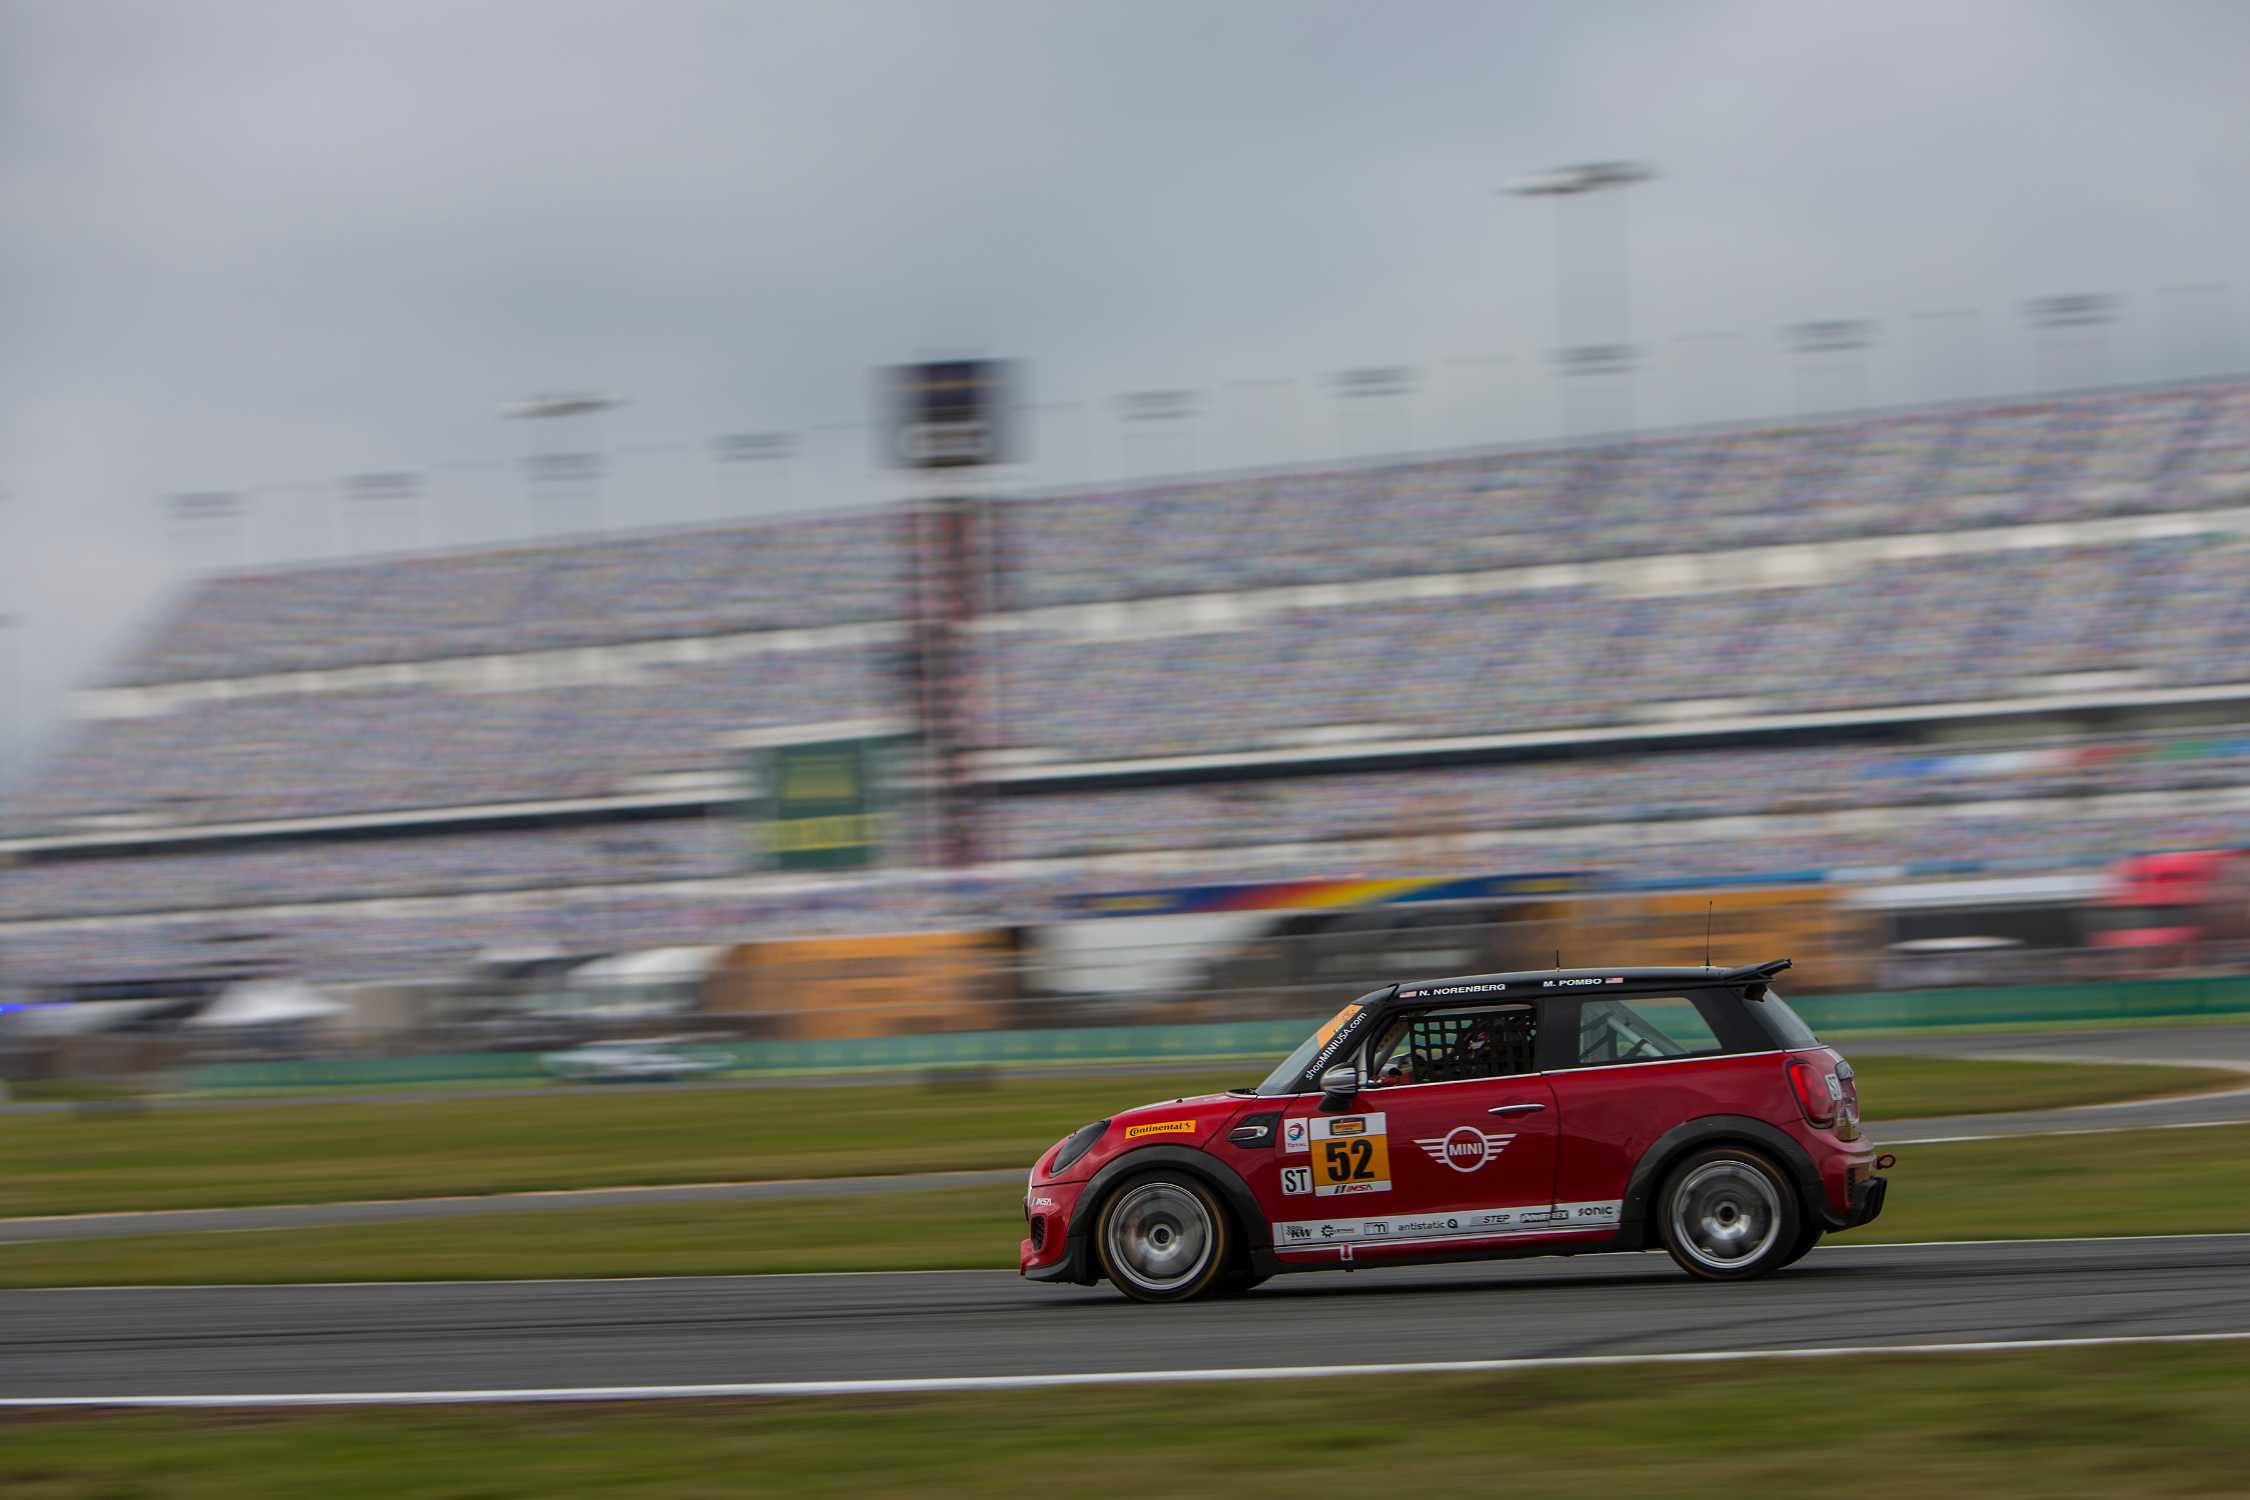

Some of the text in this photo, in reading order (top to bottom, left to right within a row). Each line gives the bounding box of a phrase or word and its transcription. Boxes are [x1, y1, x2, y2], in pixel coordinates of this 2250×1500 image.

[1433, 984, 1505, 996] NORENBERG
[1544, 978, 1602, 988] M. POMBO
[1306, 1012, 1367, 1080] shopMINIUSA.com
[1129, 1122, 1183, 1137] Continental
[1449, 1142, 1483, 1156] MINI
[1326, 1139, 1375, 1182] 52
[1284, 1169, 1308, 1193] ST
[1483, 1214, 1511, 1224] STEP
